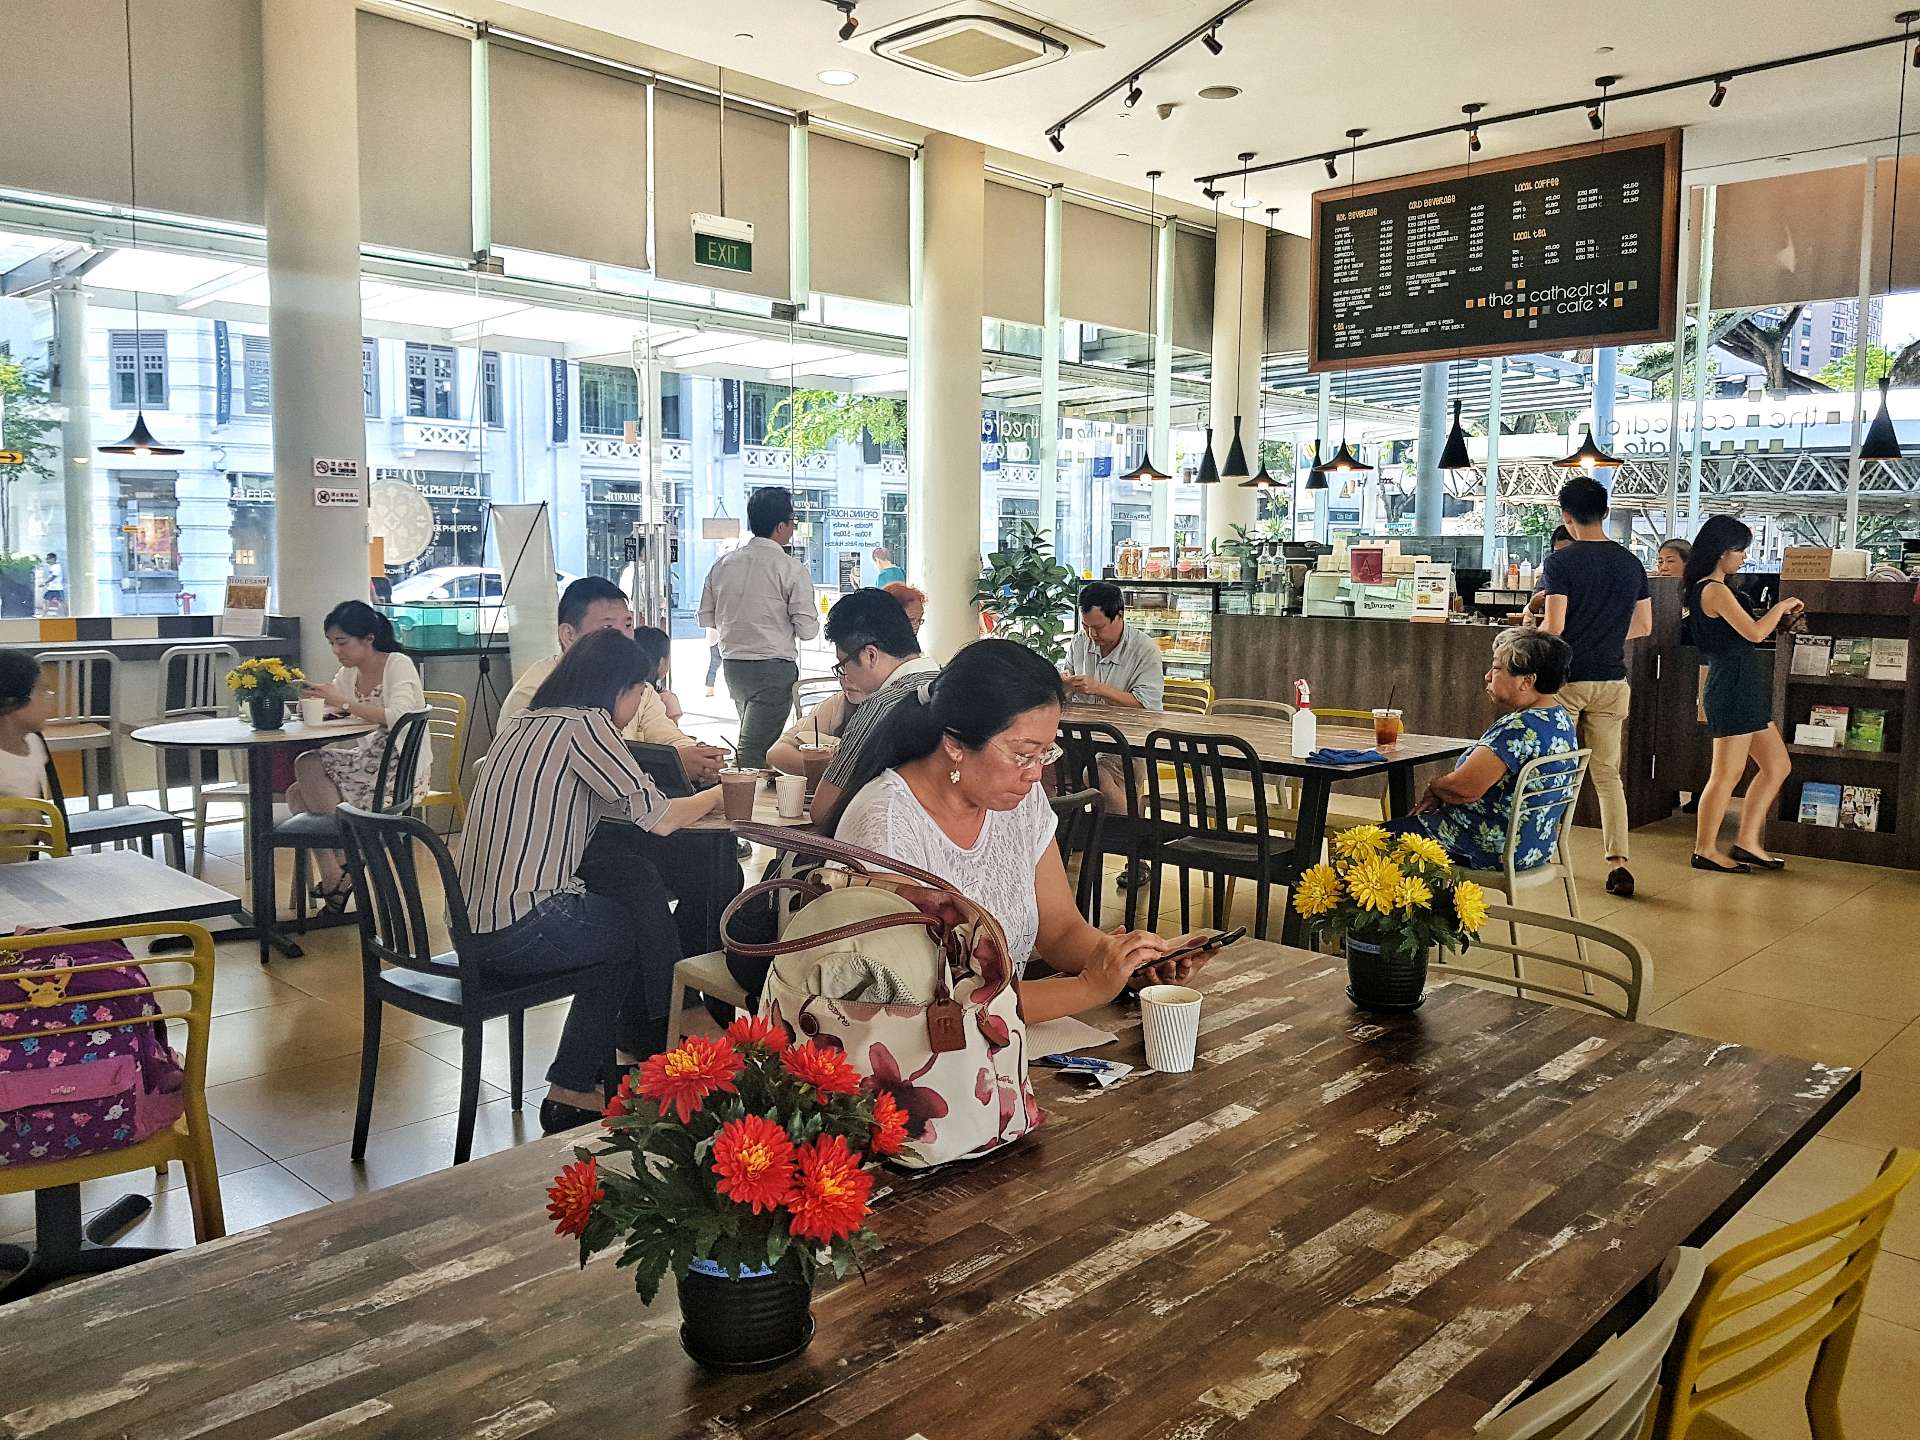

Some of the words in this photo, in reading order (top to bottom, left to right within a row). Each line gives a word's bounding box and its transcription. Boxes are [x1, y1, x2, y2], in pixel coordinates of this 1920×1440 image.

[708, 241, 739, 264] EXIT
[1488, 292, 1514, 308] the
[1530, 279, 1610, 303] cathedral
[1556, 298, 1594, 315] cafe
[430, 485, 470, 496] PHILIPPE
